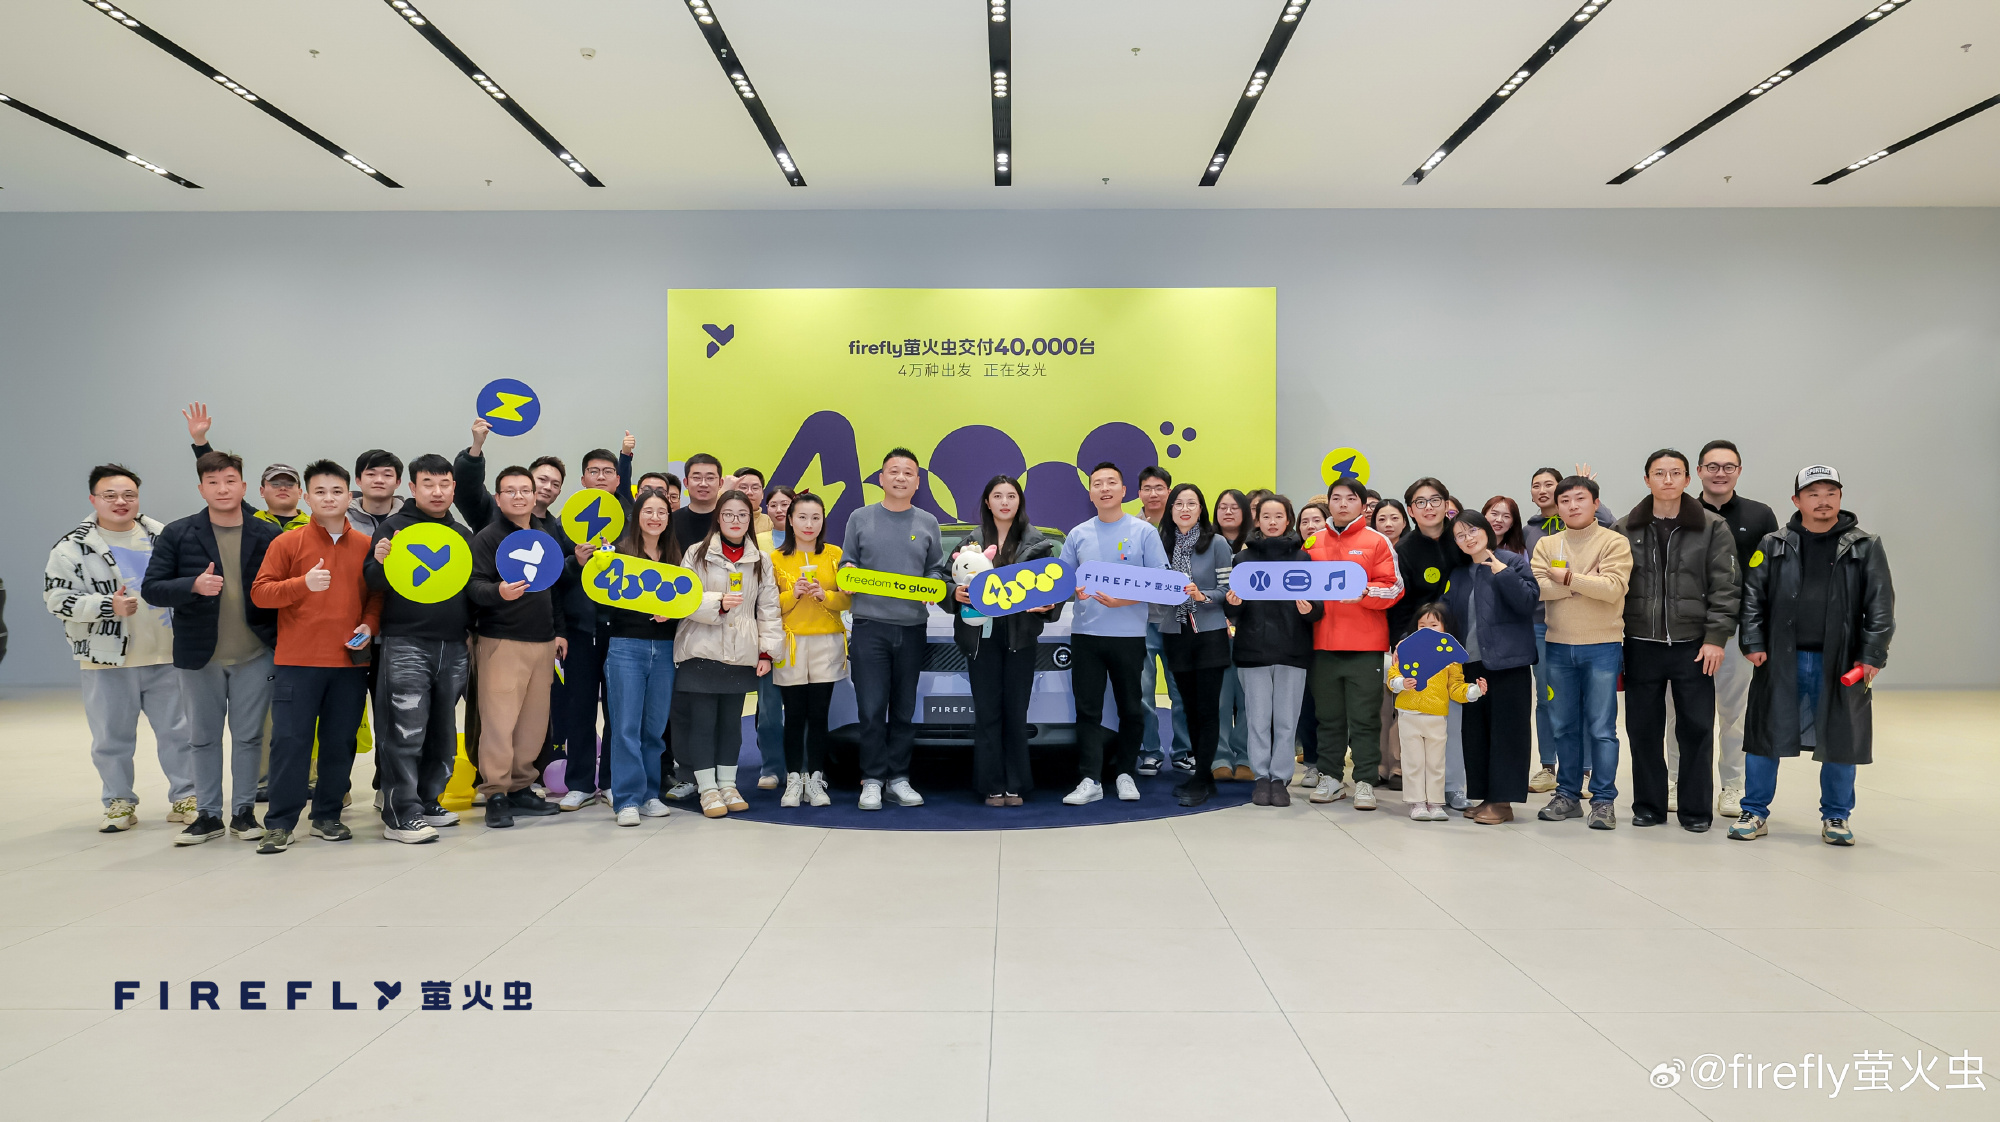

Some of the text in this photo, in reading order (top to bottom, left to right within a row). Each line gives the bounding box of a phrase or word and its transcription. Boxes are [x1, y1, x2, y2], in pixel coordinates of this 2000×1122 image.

[849, 338, 1095, 358] firefly萤火虫交付40,000台
[898, 362, 1047, 377] 4万种出发 正在发光
[846, 574, 938, 594] freedom to glow
